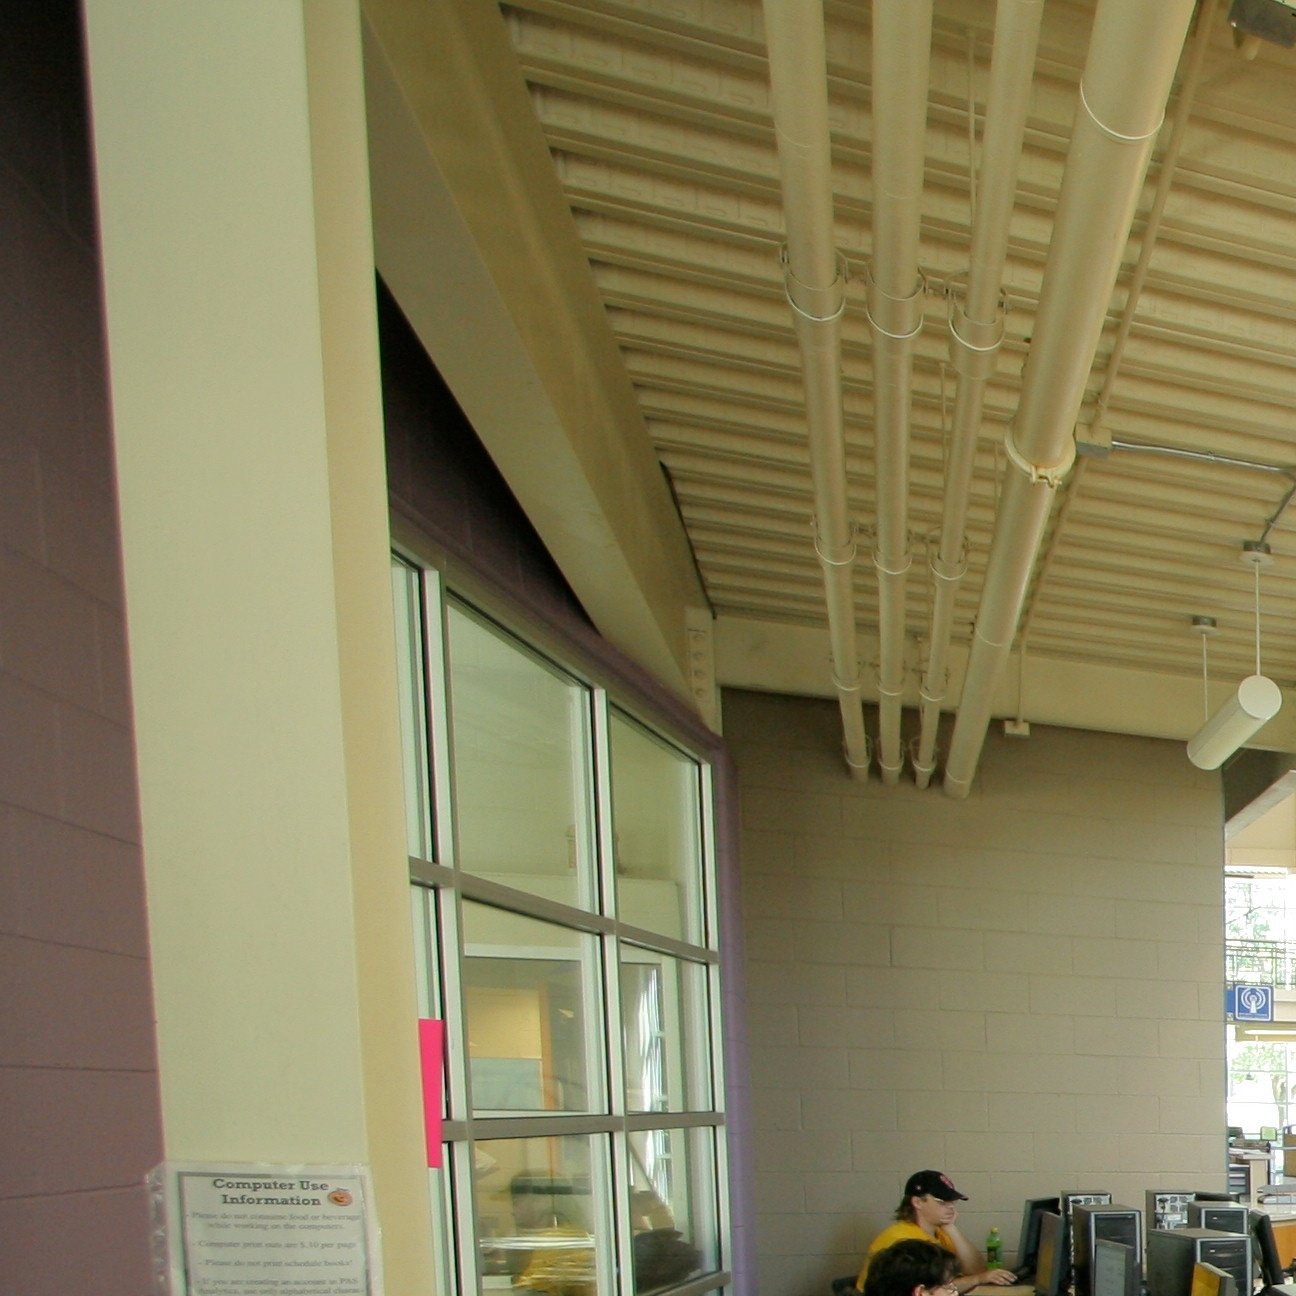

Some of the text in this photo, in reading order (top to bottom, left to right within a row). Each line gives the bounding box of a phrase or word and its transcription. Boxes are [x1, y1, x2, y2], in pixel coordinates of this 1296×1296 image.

[213, 1178, 329, 1192] Computer Use
[221, 1194, 322, 1206] Information
